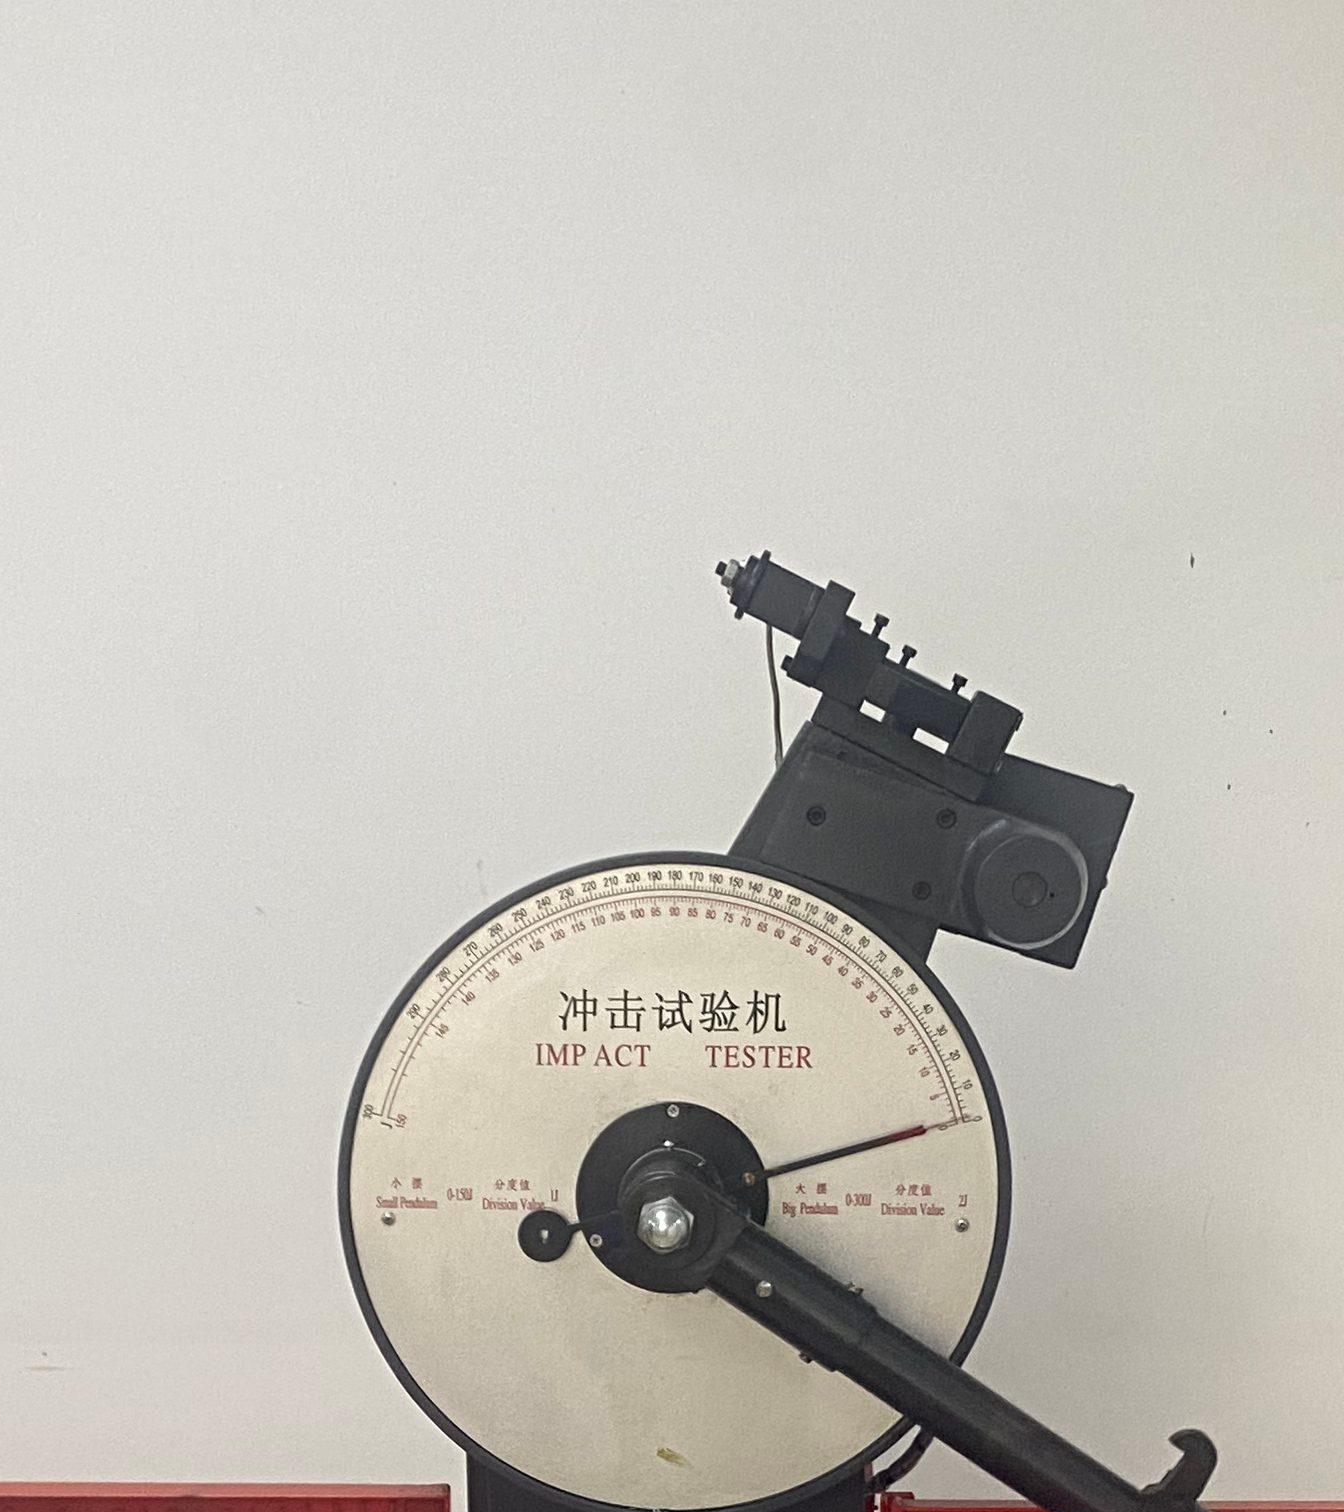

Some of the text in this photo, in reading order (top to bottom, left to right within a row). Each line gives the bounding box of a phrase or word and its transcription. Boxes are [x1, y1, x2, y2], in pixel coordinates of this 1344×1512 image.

[436, 966, 451, 983] 280
[463, 941, 479, 957] 270
[536, 896, 552, 910] 240
[558, 887, 574, 900] 230
[581, 881, 597, 893] 220
[603, 875, 619, 888] 210
[625, 872, 641, 884] 200
[647, 870, 662, 881] 190
[668, 870, 682, 881] 180
[689, 871, 704, 882] 170
[708, 873, 723, 884] 160
[729, 876, 744, 889] 150
[748, 880, 763, 893] 140
[768, 886, 783, 900] 130
[786, 894, 801, 907] 120
[805, 901, 819, 915] 110
[825, 910, 839, 925] 100
[841, 924, 854, 936] 90
[858, 936, 871, 948] 80
[875, 950, 887, 963] 70
[892, 966, 904, 978] 60
[908, 984, 919, 995] 50
[922, 1003, 934, 1015] 40
[936, 1024, 948, 1037] 30
[949, 1049, 961, 1061] 20
[962, 1079, 973, 1090] 10
[461, 991, 476, 1006] 140
[507, 952, 523, 967] 130
[529, 939, 545, 953] 125
[550, 929, 566, 941] 120
[571, 922, 586, 934] 115
[591, 915, 606, 927] 110
[611, 910, 626, 922] 105
[630, 908, 645, 919] 100
[651, 907, 662, 917] 95
[669, 907, 680, 916] 90
[687, 907, 699, 917] 85
[706, 909, 717, 919] 80
[723, 912, 734, 923] 75
[740, 916, 751, 928] 70
[757, 921, 768, 933] 65
[774, 928, 785, 940] 60
[790, 935, 801, 947] 55
[806, 943, 817, 956] 50
[822, 954, 833, 966] 45
[838, 965, 849, 977] 40
[879, 1007, 892, 1019] 25
[893, 1024, 905, 1036] 20
[906, 1044, 918, 1056] 15
[918, 1066, 930, 1078] 10
[558, 988, 787, 1034] 冲击试验机
[706, 1045, 813, 1069] TESTER
[896, 1183, 932, 1196] 分度值
[482, 1197, 518, 1210] Division
[782, 1202, 797, 1217] Big
[881, 1203, 945, 1216] Division Value
